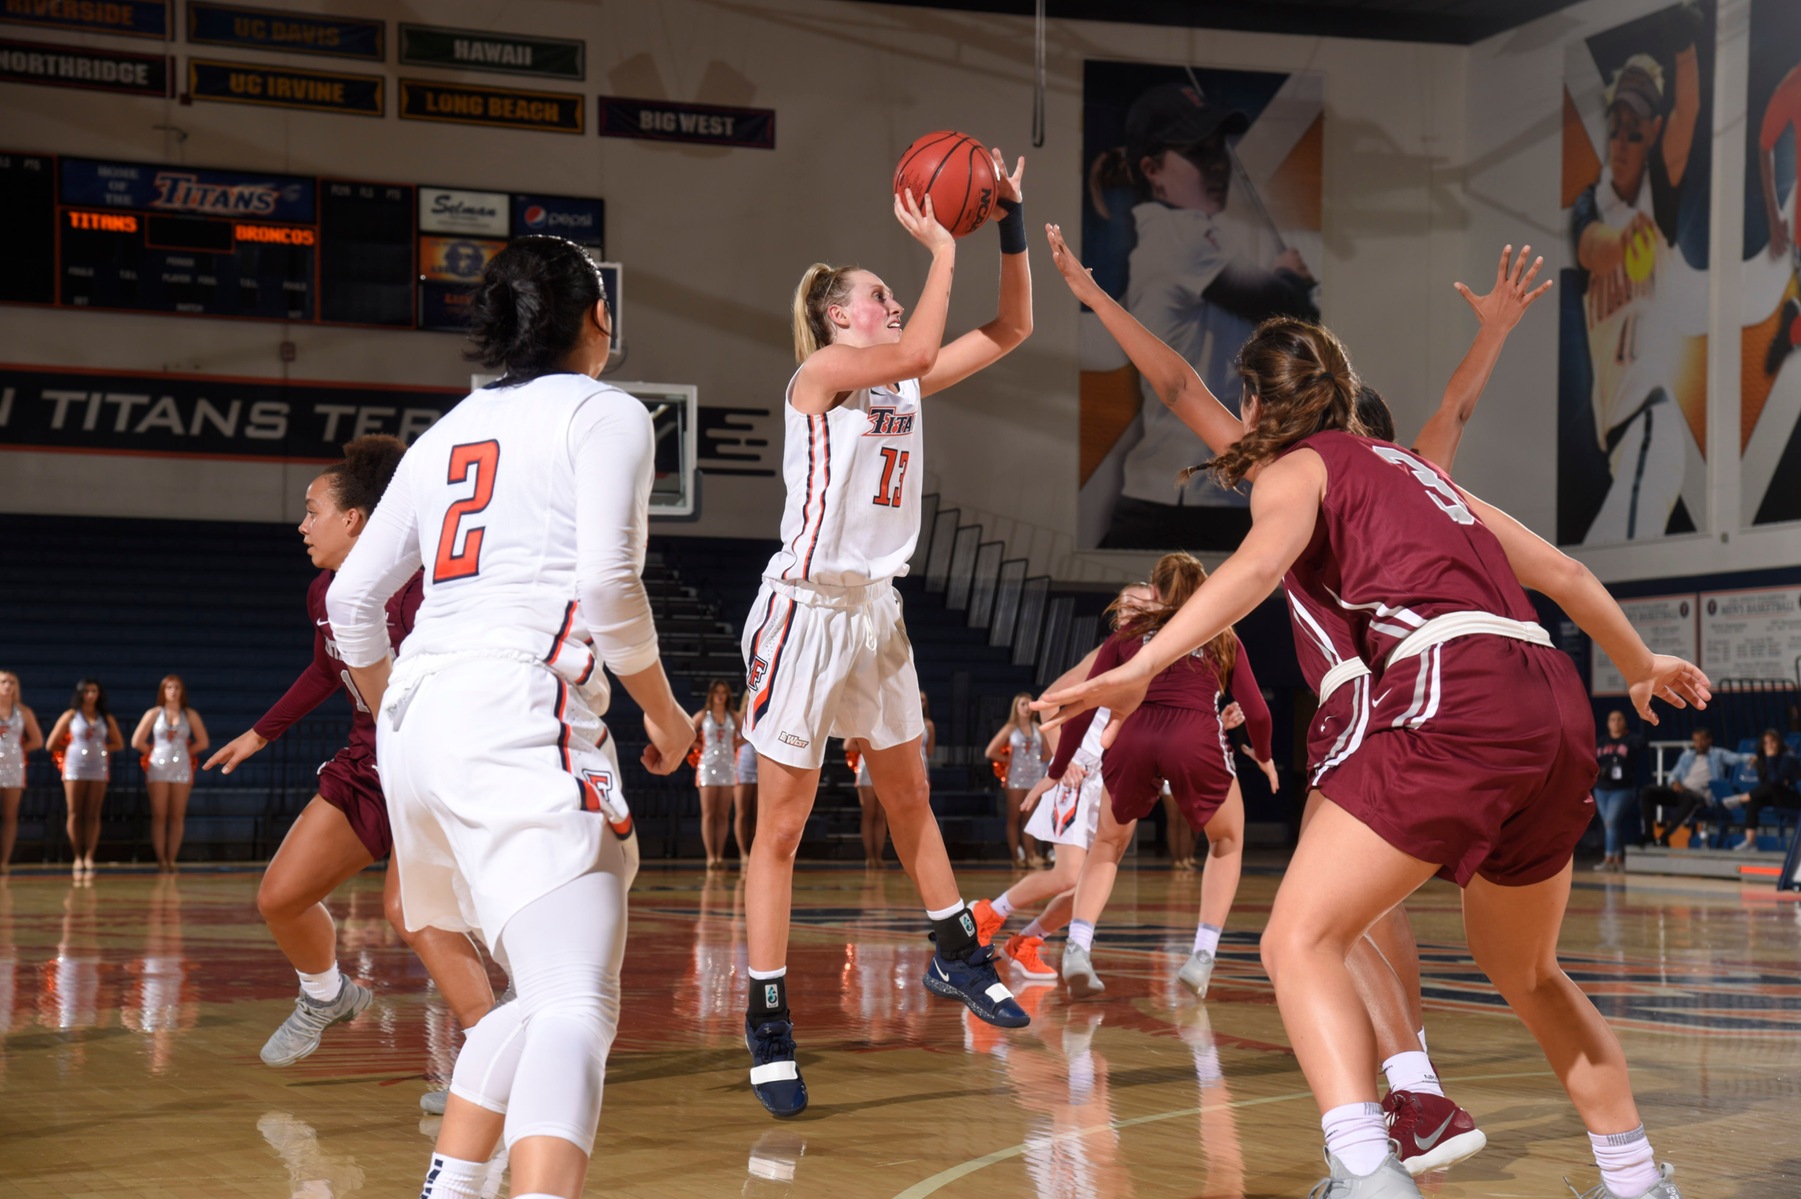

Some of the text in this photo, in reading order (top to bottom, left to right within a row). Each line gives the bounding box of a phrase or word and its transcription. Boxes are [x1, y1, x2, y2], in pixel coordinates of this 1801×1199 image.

[5, 0, 135, 26] RIVERSIDE
[233, 17, 341, 47] UC DAVIS
[0, 50, 149, 86] NORTHRIDGE
[453, 38, 533, 66] HAWAII
[229, 72, 345, 103] UC IRVINE
[425, 91, 560, 123] LONG BEACH
[639, 109, 735, 137] BIG WEST
[153, 171, 281, 217] TITANS
[68, 211, 316, 246] TITANS BRONCOS
[548, 211, 593, 228] pepsi
[41, 389, 291, 440] TITANS
[873, 446, 910, 508] 13
[1372, 445, 1475, 525] 3
[433, 438, 500, 584] 2
